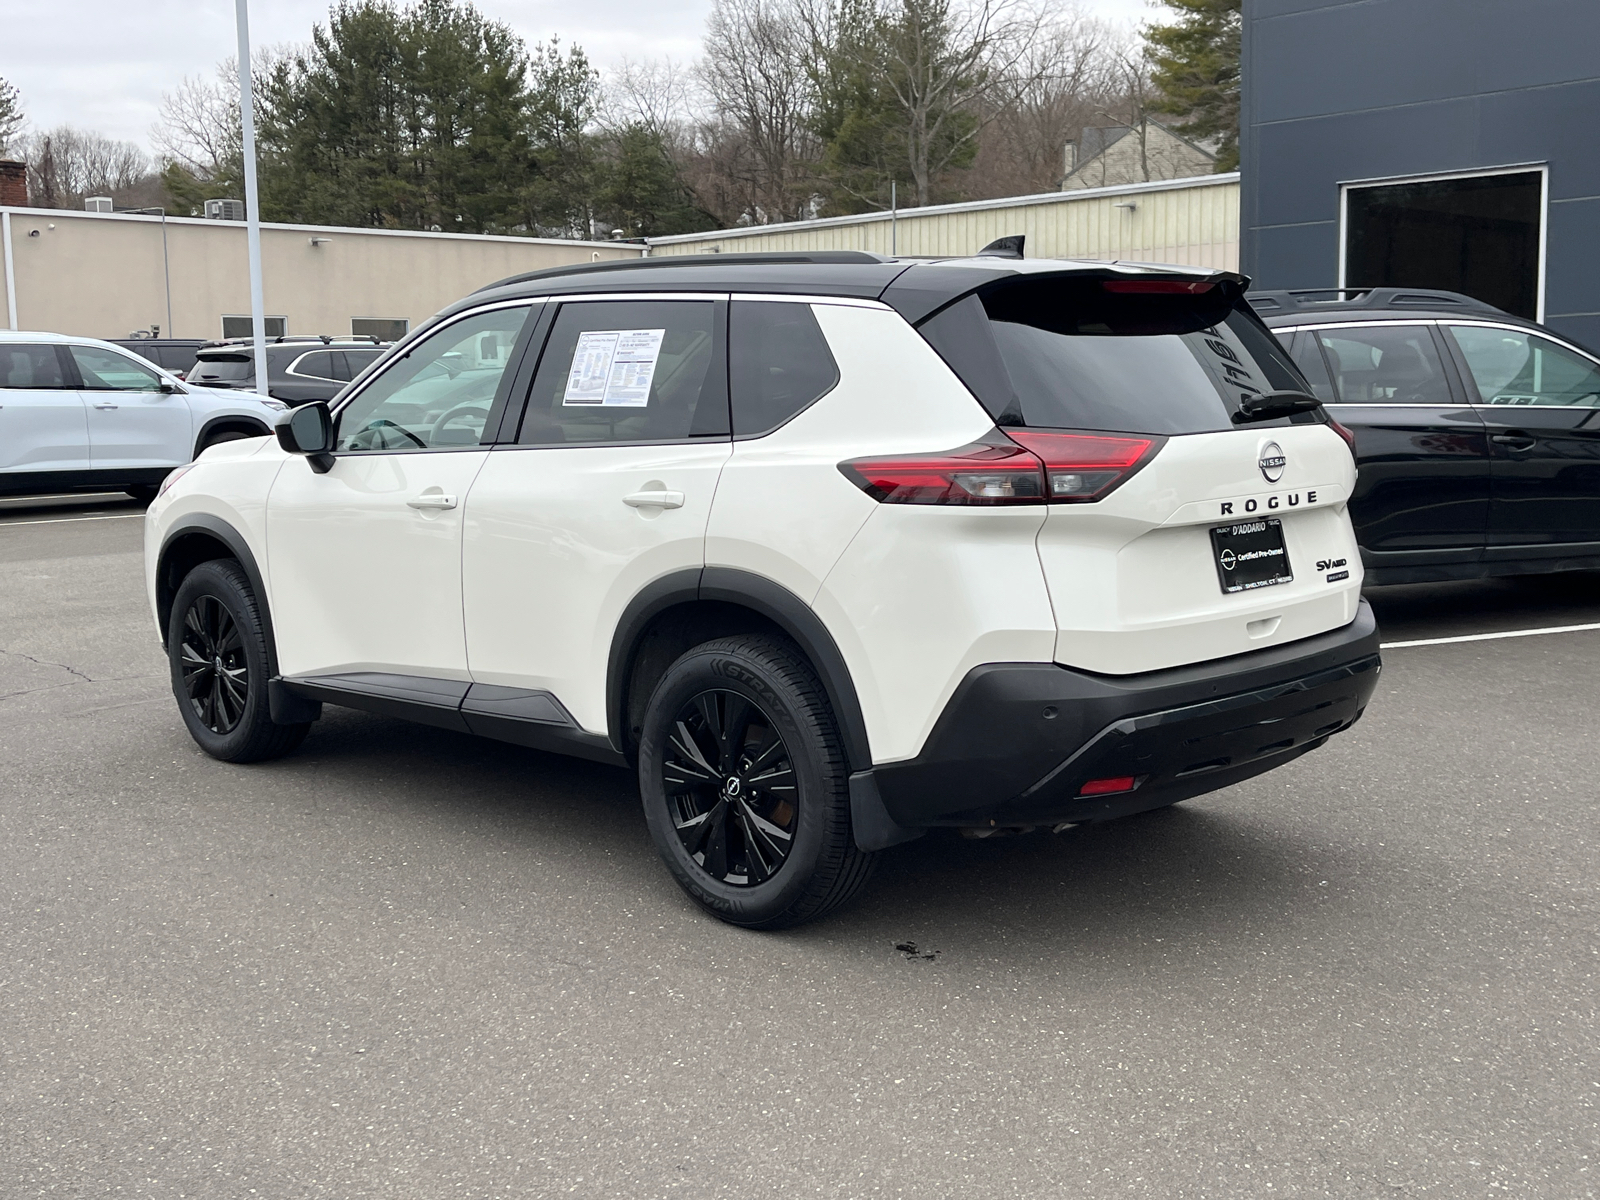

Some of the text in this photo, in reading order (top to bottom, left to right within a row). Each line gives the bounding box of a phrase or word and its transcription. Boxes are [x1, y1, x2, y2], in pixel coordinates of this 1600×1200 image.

[1259, 457, 1286, 468] NISSAN
[1220, 491, 1318, 515] ROGUE
[1232, 522, 1266, 536] D'ADDARIO
[1237, 547, 1284, 562] Certified Pre-Owned
[1315, 558, 1332, 571] SV
